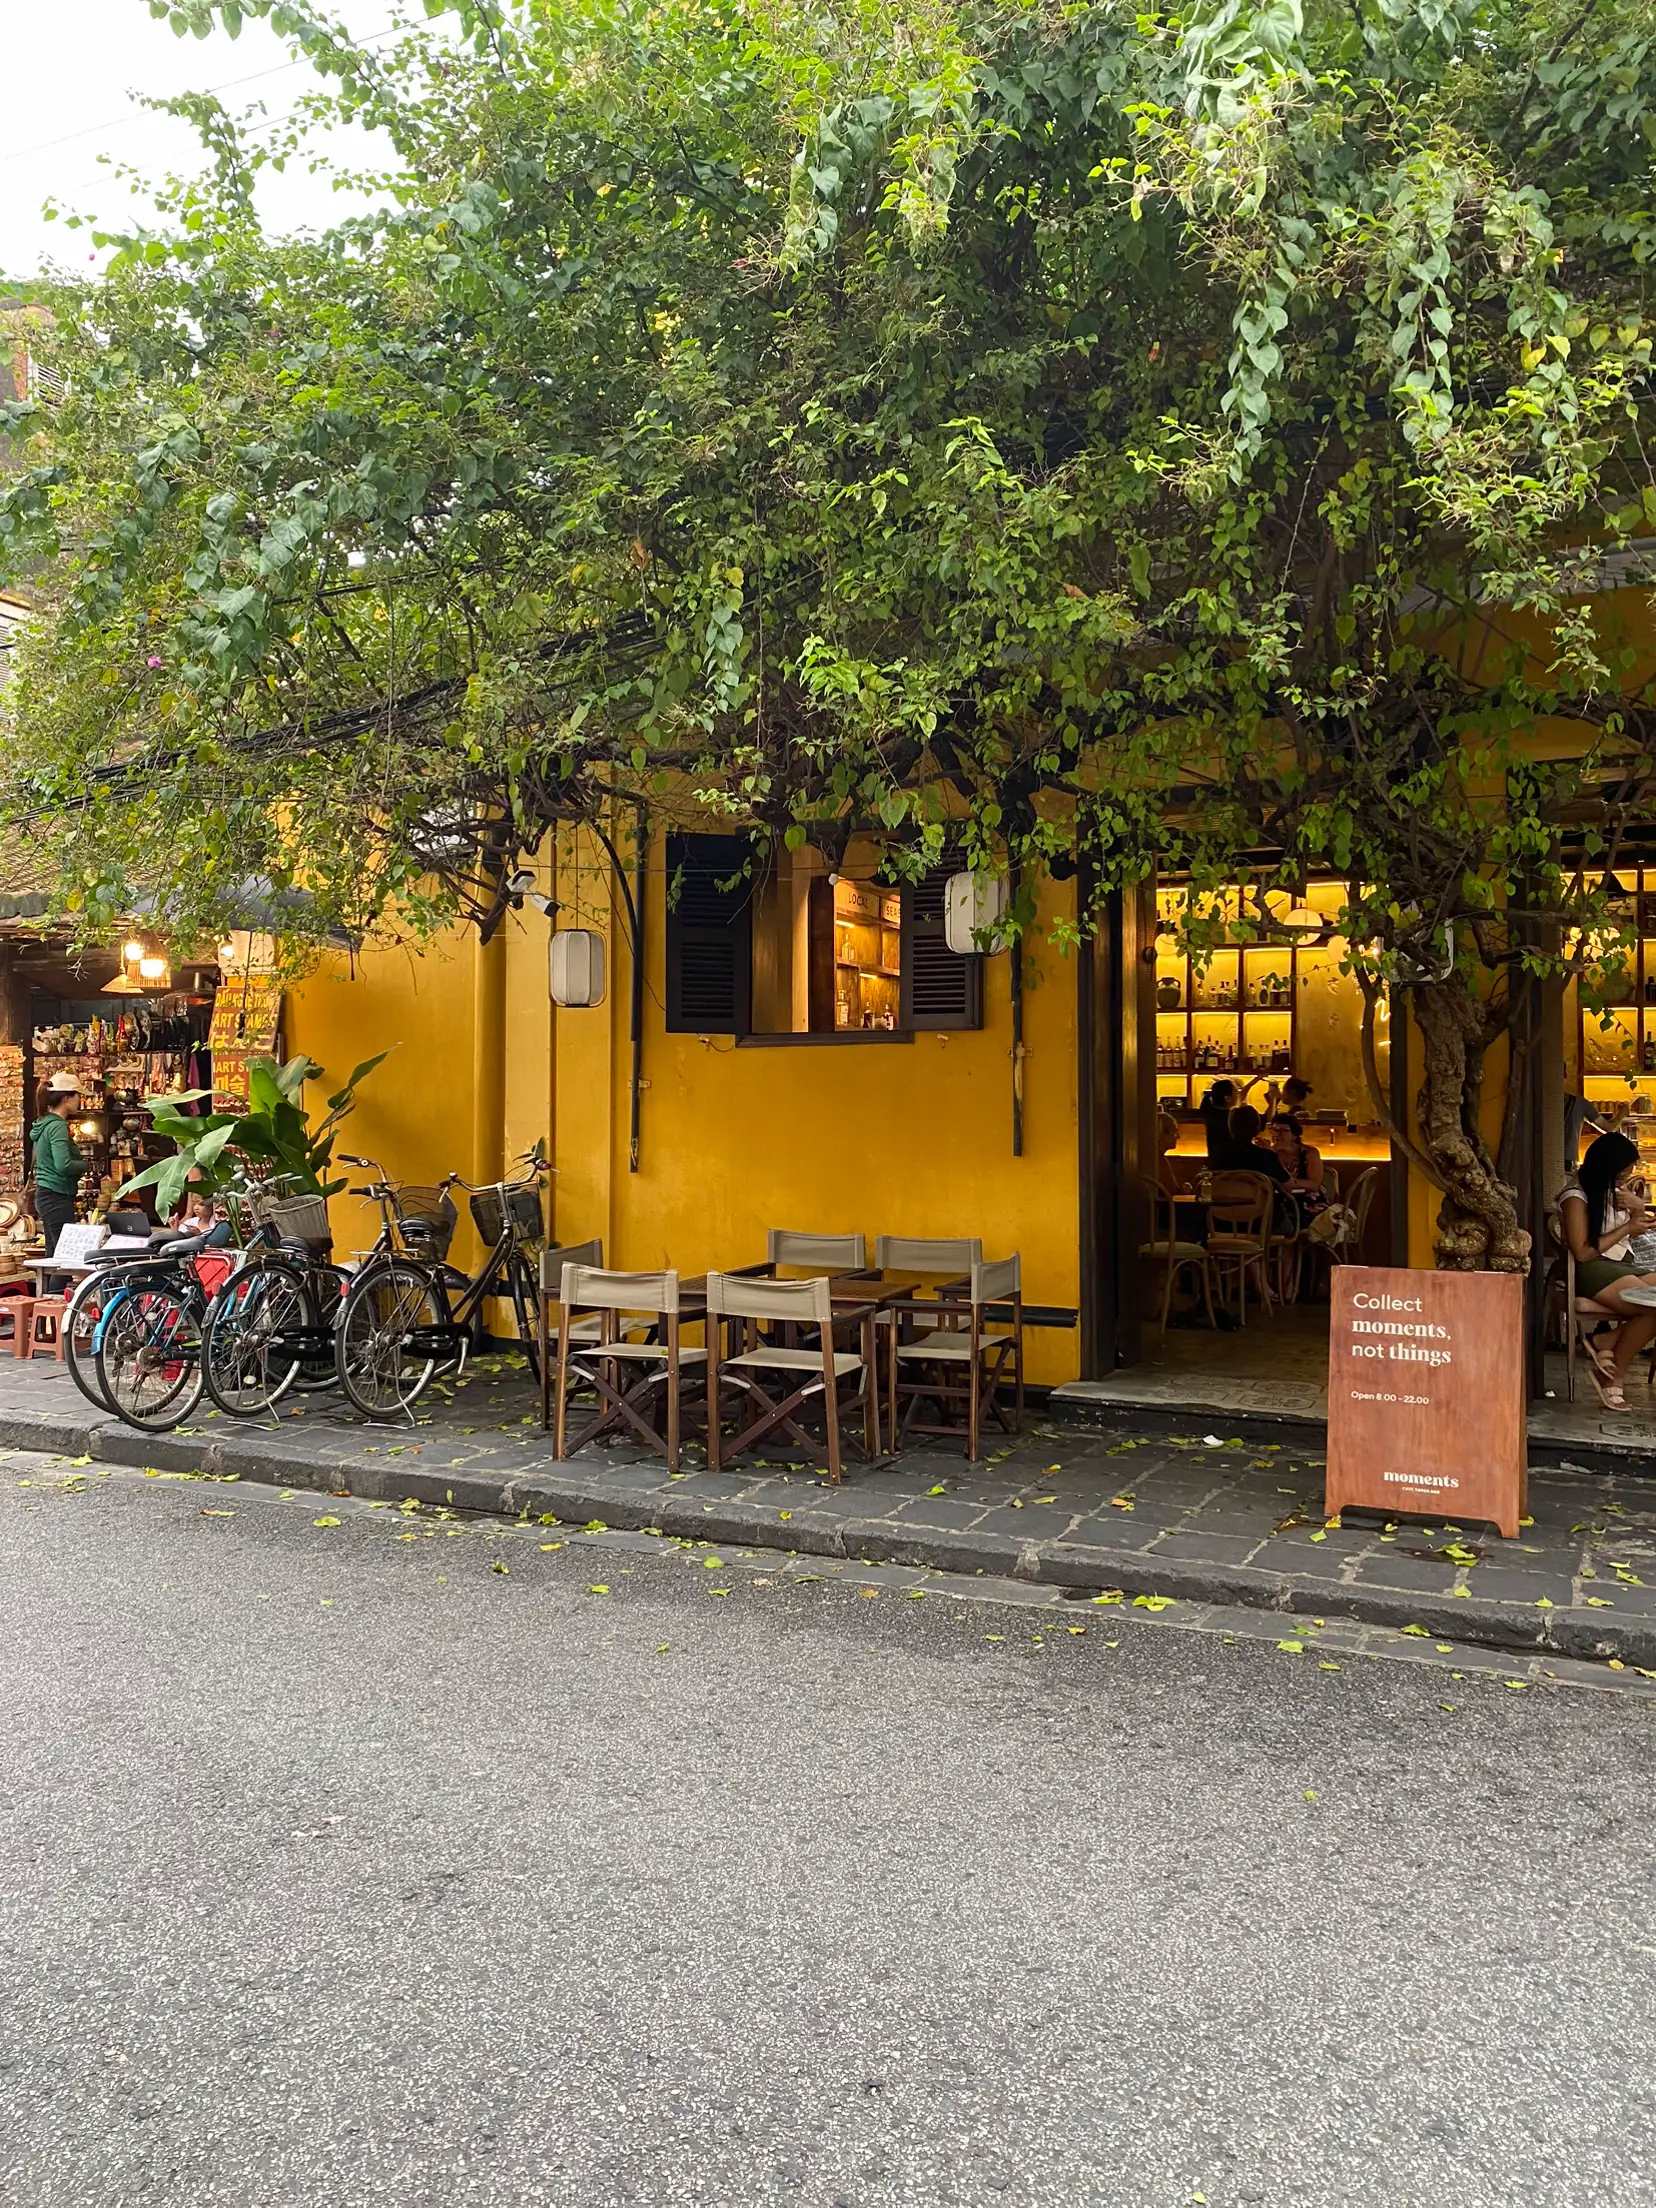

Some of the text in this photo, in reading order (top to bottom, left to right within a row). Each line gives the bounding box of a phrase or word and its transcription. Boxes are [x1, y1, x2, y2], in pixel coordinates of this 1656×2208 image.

[212, 1012, 276, 1029] ART SAMPS
[215, 1061, 235, 1073] ART
[1353, 1292, 1423, 1312] Collect
[1352, 1320, 1451, 1340] moments,
[1352, 1343, 1451, 1367] not things
[1351, 1390, 1374, 1400] Open
[1383, 1471, 1459, 1488] moments
